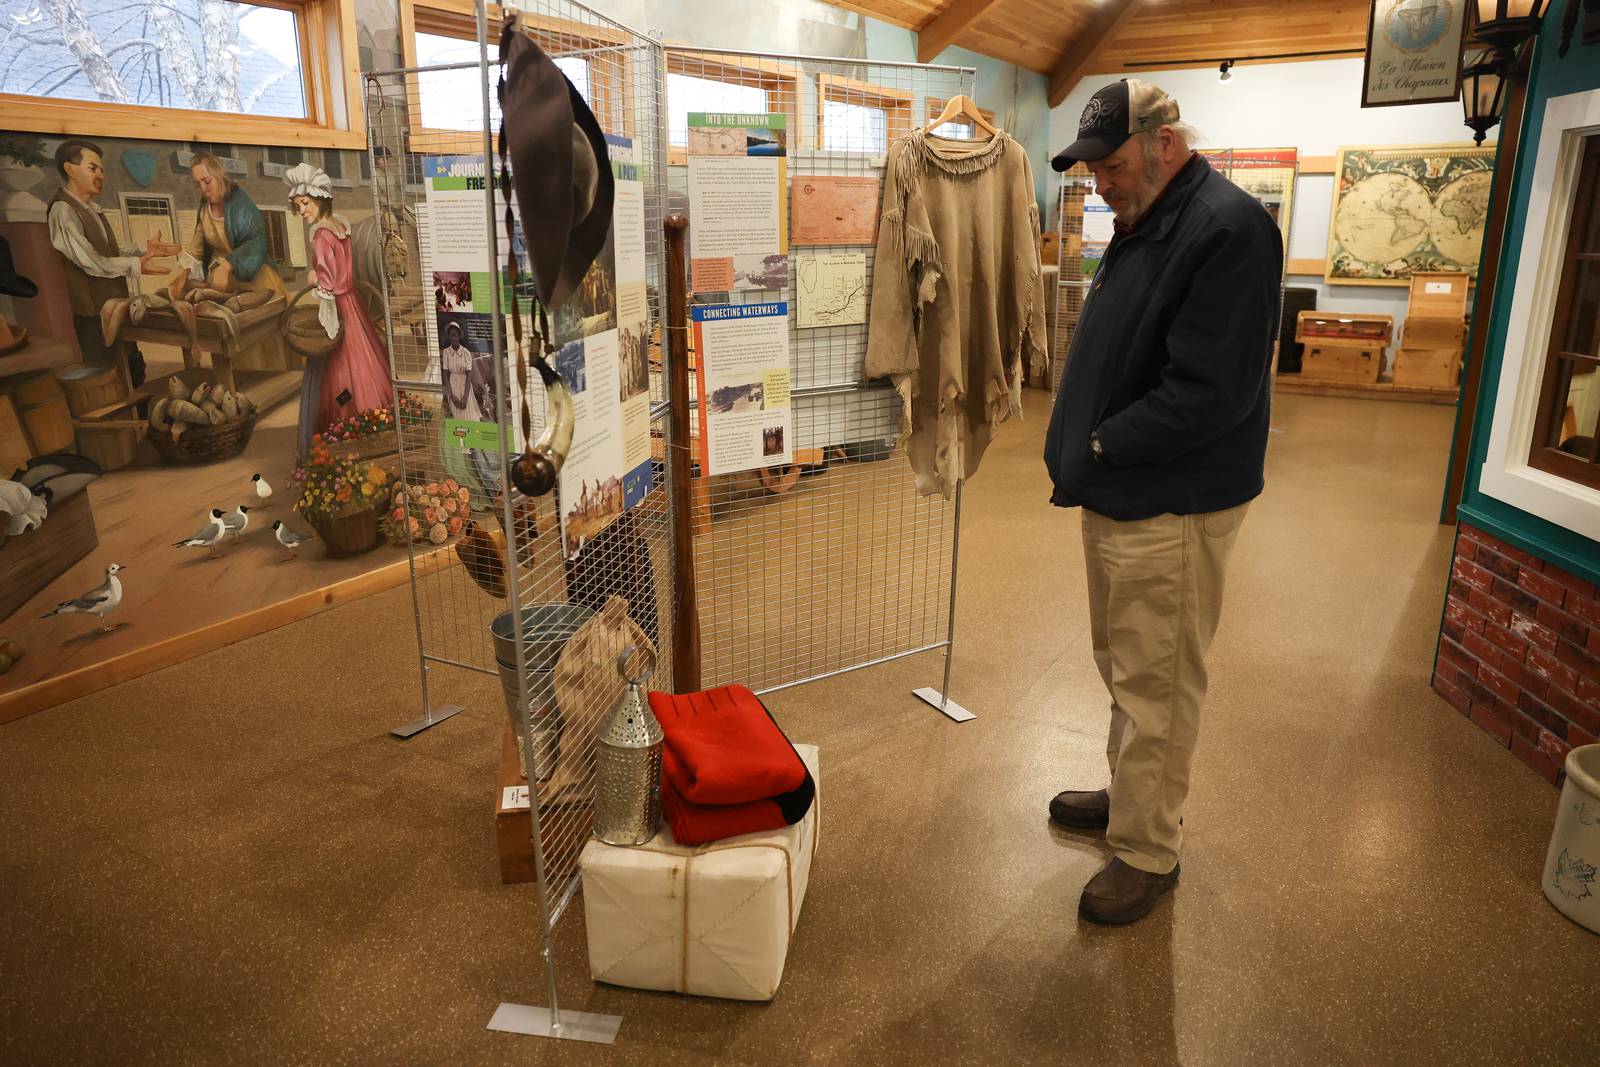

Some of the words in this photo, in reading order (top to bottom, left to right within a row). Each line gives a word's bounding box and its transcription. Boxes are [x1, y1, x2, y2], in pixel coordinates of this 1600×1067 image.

[1377, 61, 1398, 75] La
[1403, 57, 1447, 73] Maison
[1372, 79, 1390, 92] des
[1393, 75, 1449, 94] Chapeaux
[705, 112, 721, 124] INTO
[723, 114, 736, 125] THE
[737, 114, 769, 126] UNKNOWN
[703, 308, 741, 319] CONNECTING
[742, 305, 779, 316] WATERWAYS
